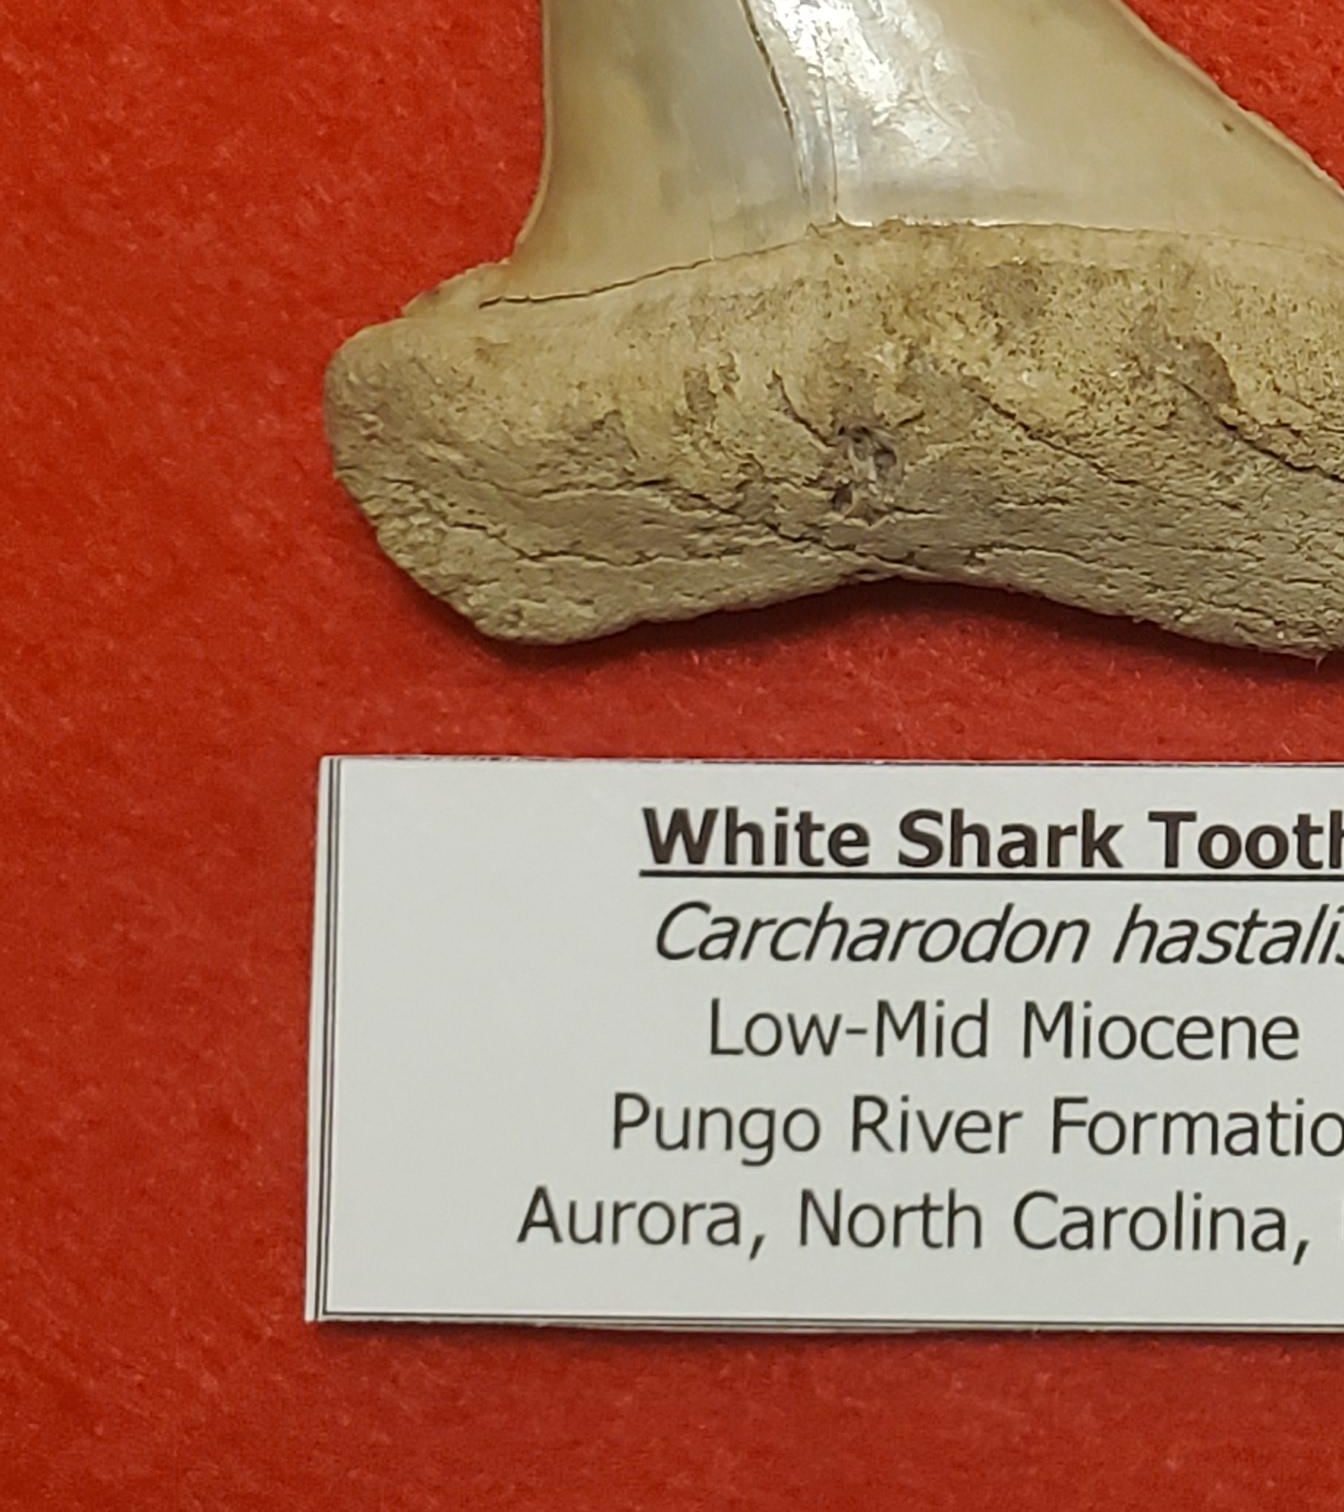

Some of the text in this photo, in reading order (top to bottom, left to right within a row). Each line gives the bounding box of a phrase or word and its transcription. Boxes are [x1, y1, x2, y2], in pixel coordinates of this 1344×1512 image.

[641, 805, 871, 869] White
[897, 807, 1124, 870] Shark
[655, 900, 1091, 965] Carcharodon
[709, 997, 1300, 1062] Low-Mid Miocene
[612, 1091, 822, 1168] Pungo
[851, 1094, 1024, 1155] River
[516, 1185, 765, 1261] Aurora,
[799, 1187, 983, 1250] North
[1012, 1189, 1310, 1267] Carolina,
